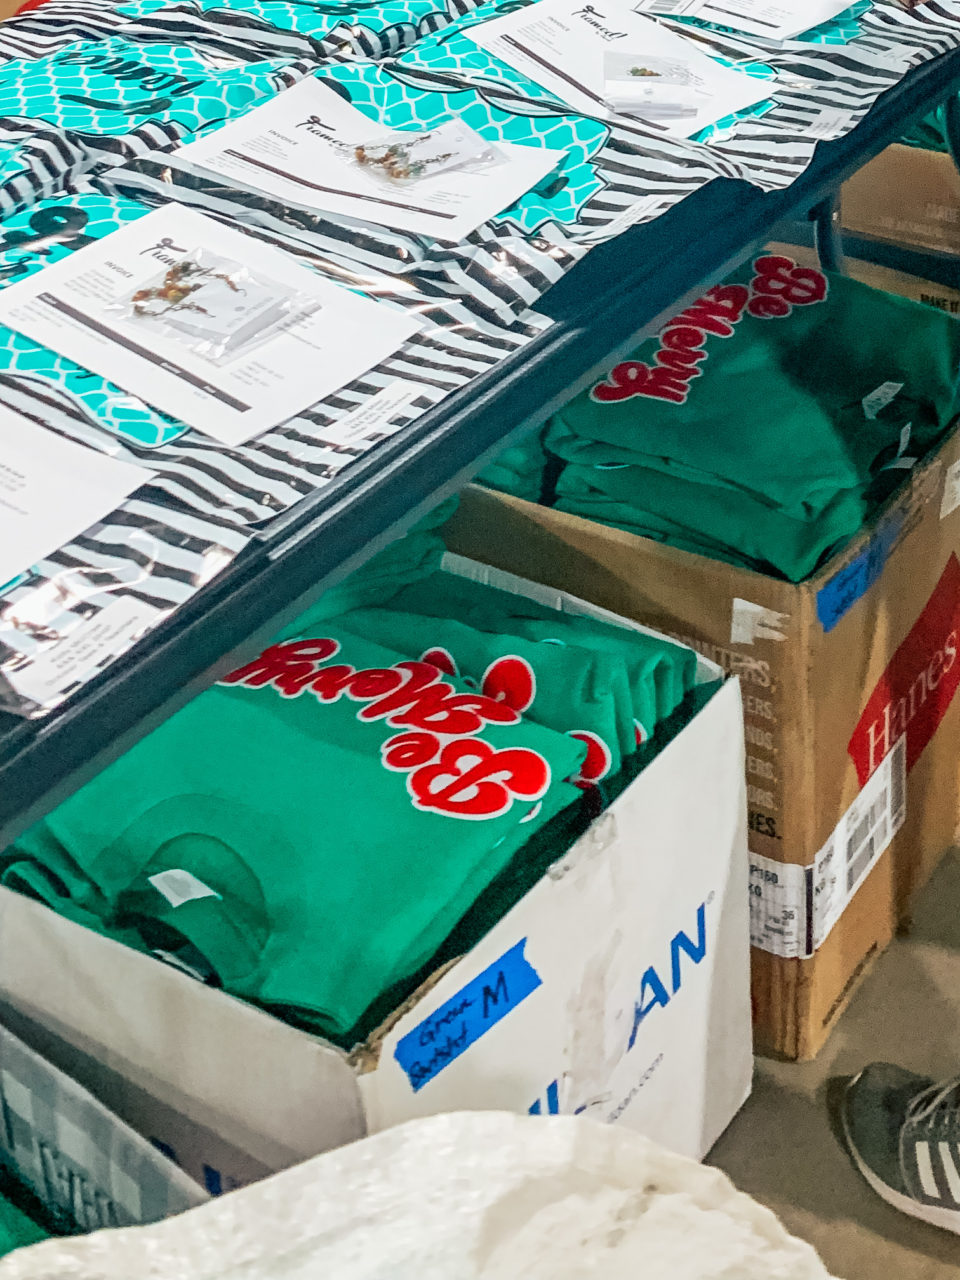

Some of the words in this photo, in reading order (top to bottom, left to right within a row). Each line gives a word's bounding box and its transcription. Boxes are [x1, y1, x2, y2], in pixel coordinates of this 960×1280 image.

[267, 129, 299, 146] INVOICE
[103, 260, 134, 279] INVOICE
[866, 630, 958, 778] Hanes
[380, 730, 552, 821] Be
[482, 970, 510, 1020] M
